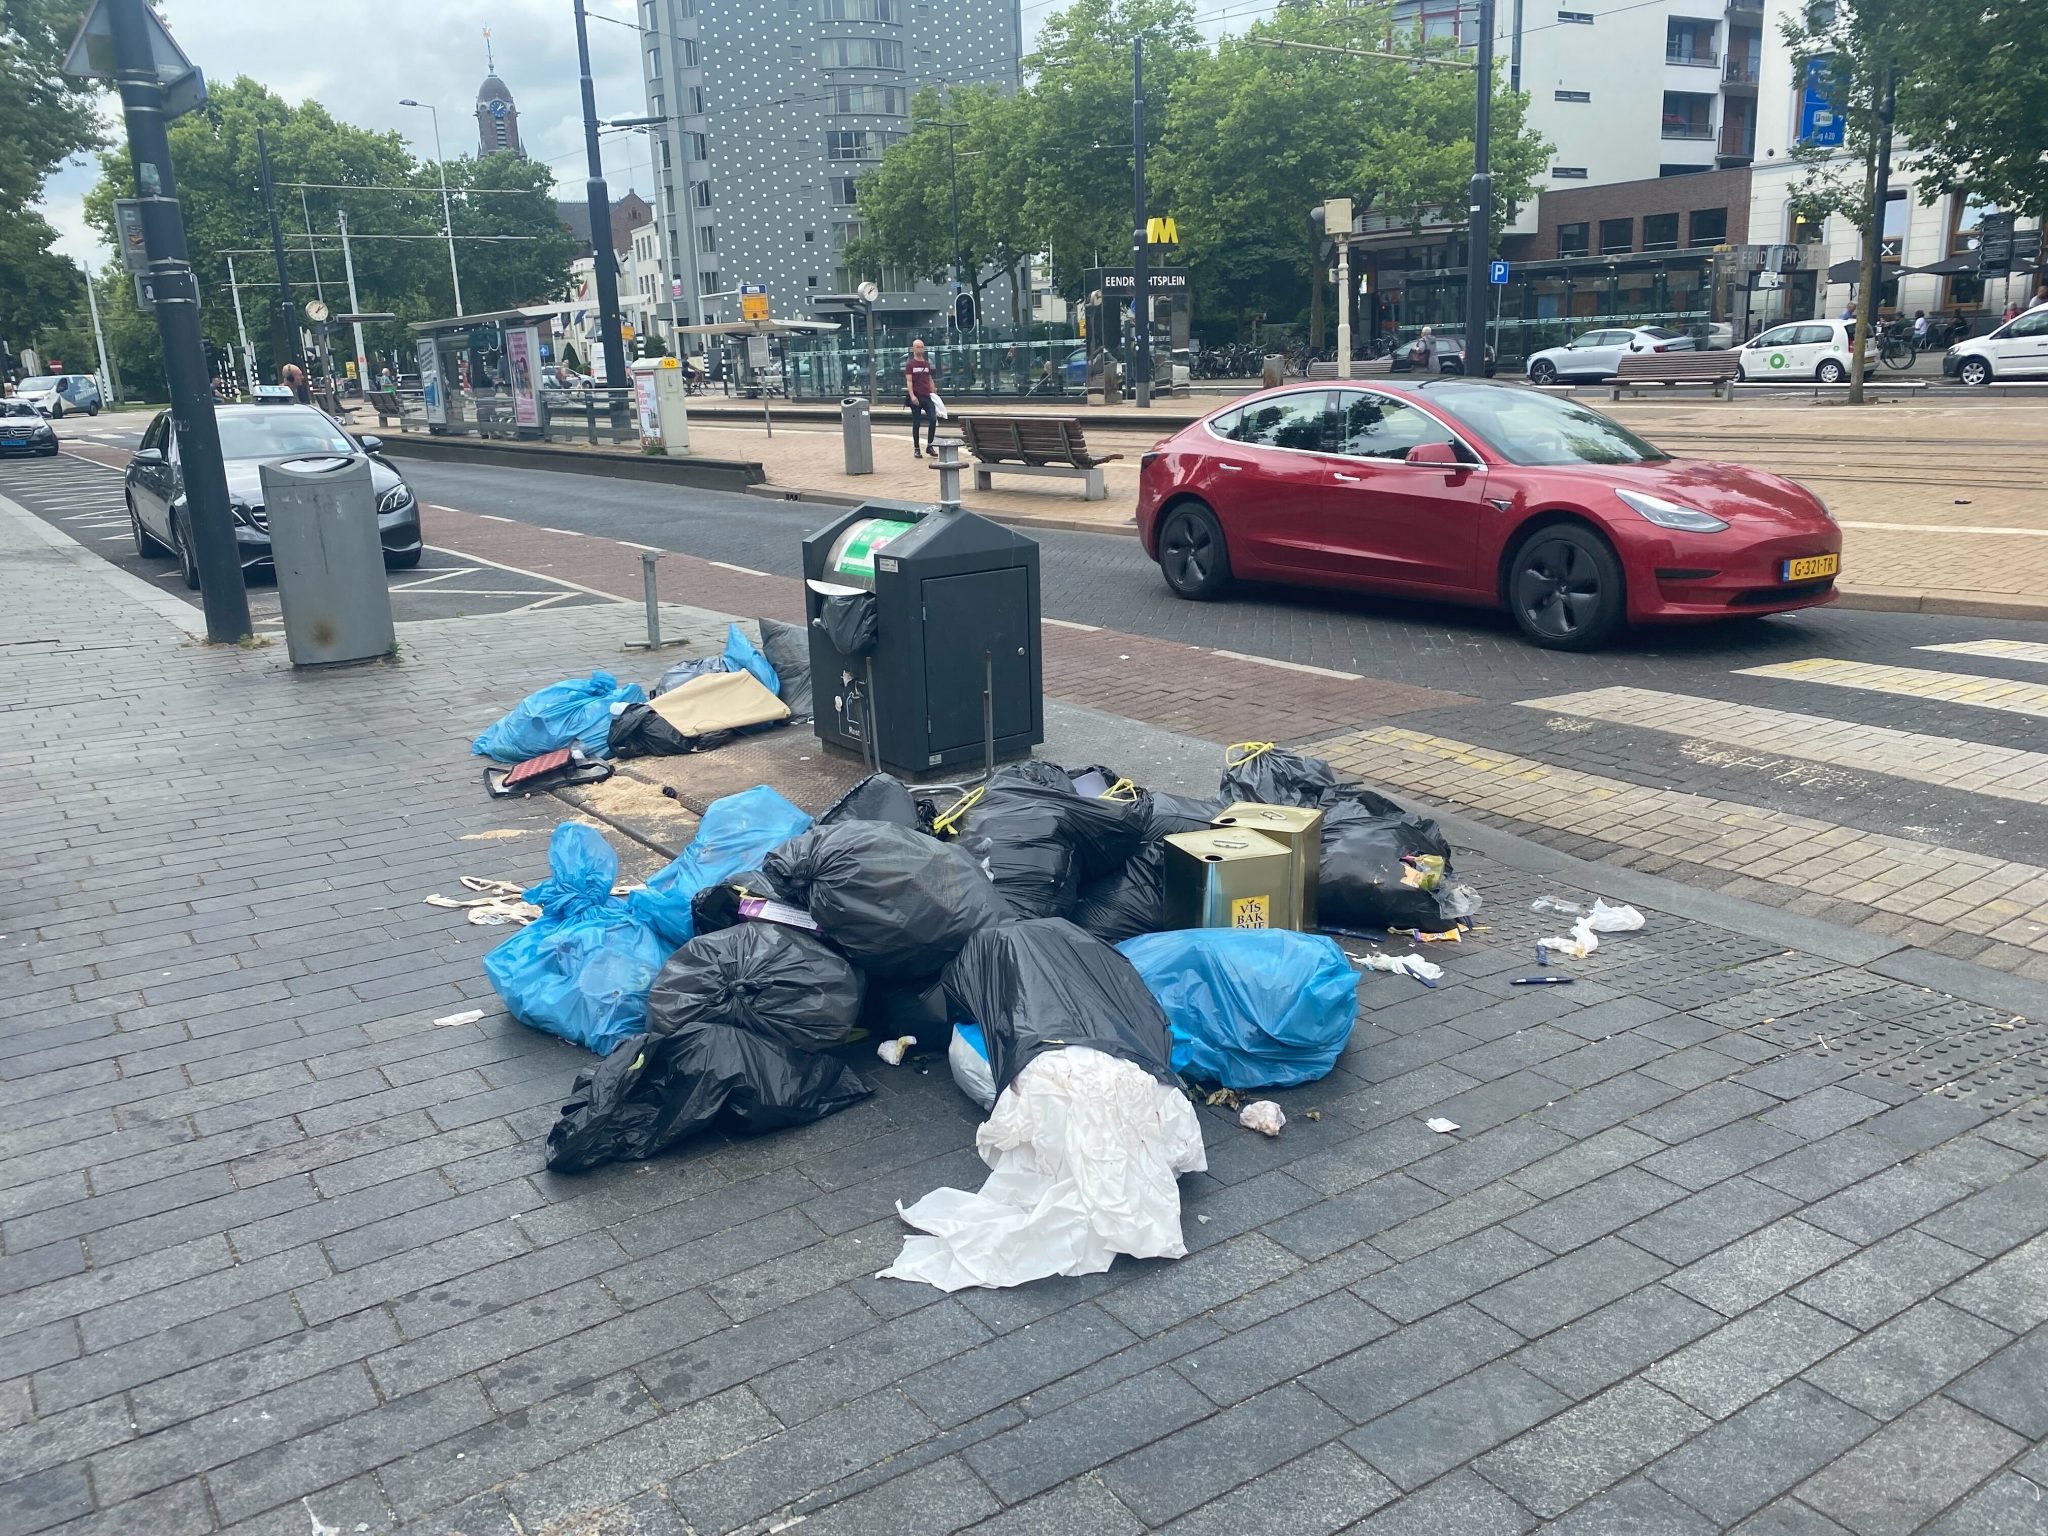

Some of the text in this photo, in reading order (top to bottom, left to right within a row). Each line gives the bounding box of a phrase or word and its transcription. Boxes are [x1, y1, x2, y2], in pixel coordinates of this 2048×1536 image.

[1147, 217, 1178, 243] M
[1495, 264, 1505, 281] P
[1105, 276, 1185, 287] EENDRHTSPLEIN
[1795, 557, 1833, 576] G-321-TR
[1240, 902, 1261, 914] VIS
[1237, 912, 1264, 924] BAK
